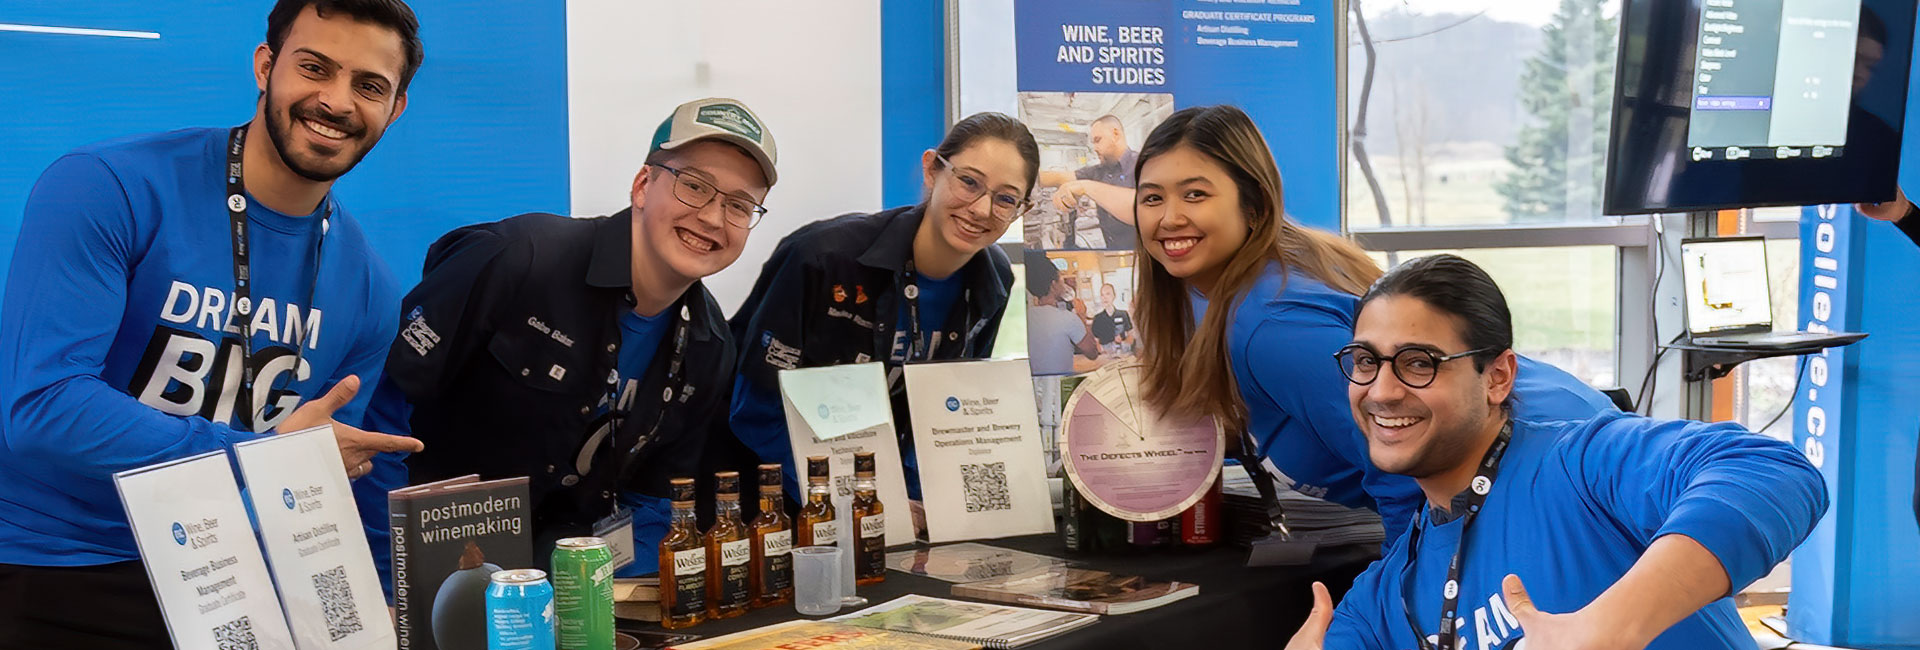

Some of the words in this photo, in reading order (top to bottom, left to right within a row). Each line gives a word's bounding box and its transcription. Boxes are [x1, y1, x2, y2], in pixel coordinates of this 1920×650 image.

[1182, 10, 1224, 20] GRADUATE
[1224, 11, 1272, 22] CERTIFICATE
[1272, 13, 1316, 23] PROGRAMS
[1062, 24, 1114, 45] WINE,
[1118, 26, 1164, 44] BEER
[1057, 45, 1095, 63] AND
[1098, 46, 1165, 65] SPIRITS
[1092, 66, 1165, 85] STUDIES
[138, 333, 311, 433] BIG
[982, 396, 999, 406] Beer
[931, 426, 974, 436] Brewmaster
[977, 424, 990, 433] and
[992, 423, 1021, 432] Brewery
[934, 439, 973, 449] Operations
[975, 436, 1022, 446] Management
[1080, 454, 1099, 462] THE
[1100, 452, 1142, 461] DEFECTS
[420, 495, 521, 528] postmodern
[420, 516, 521, 544] winemaking
[392, 526, 411, 611] postmodern
